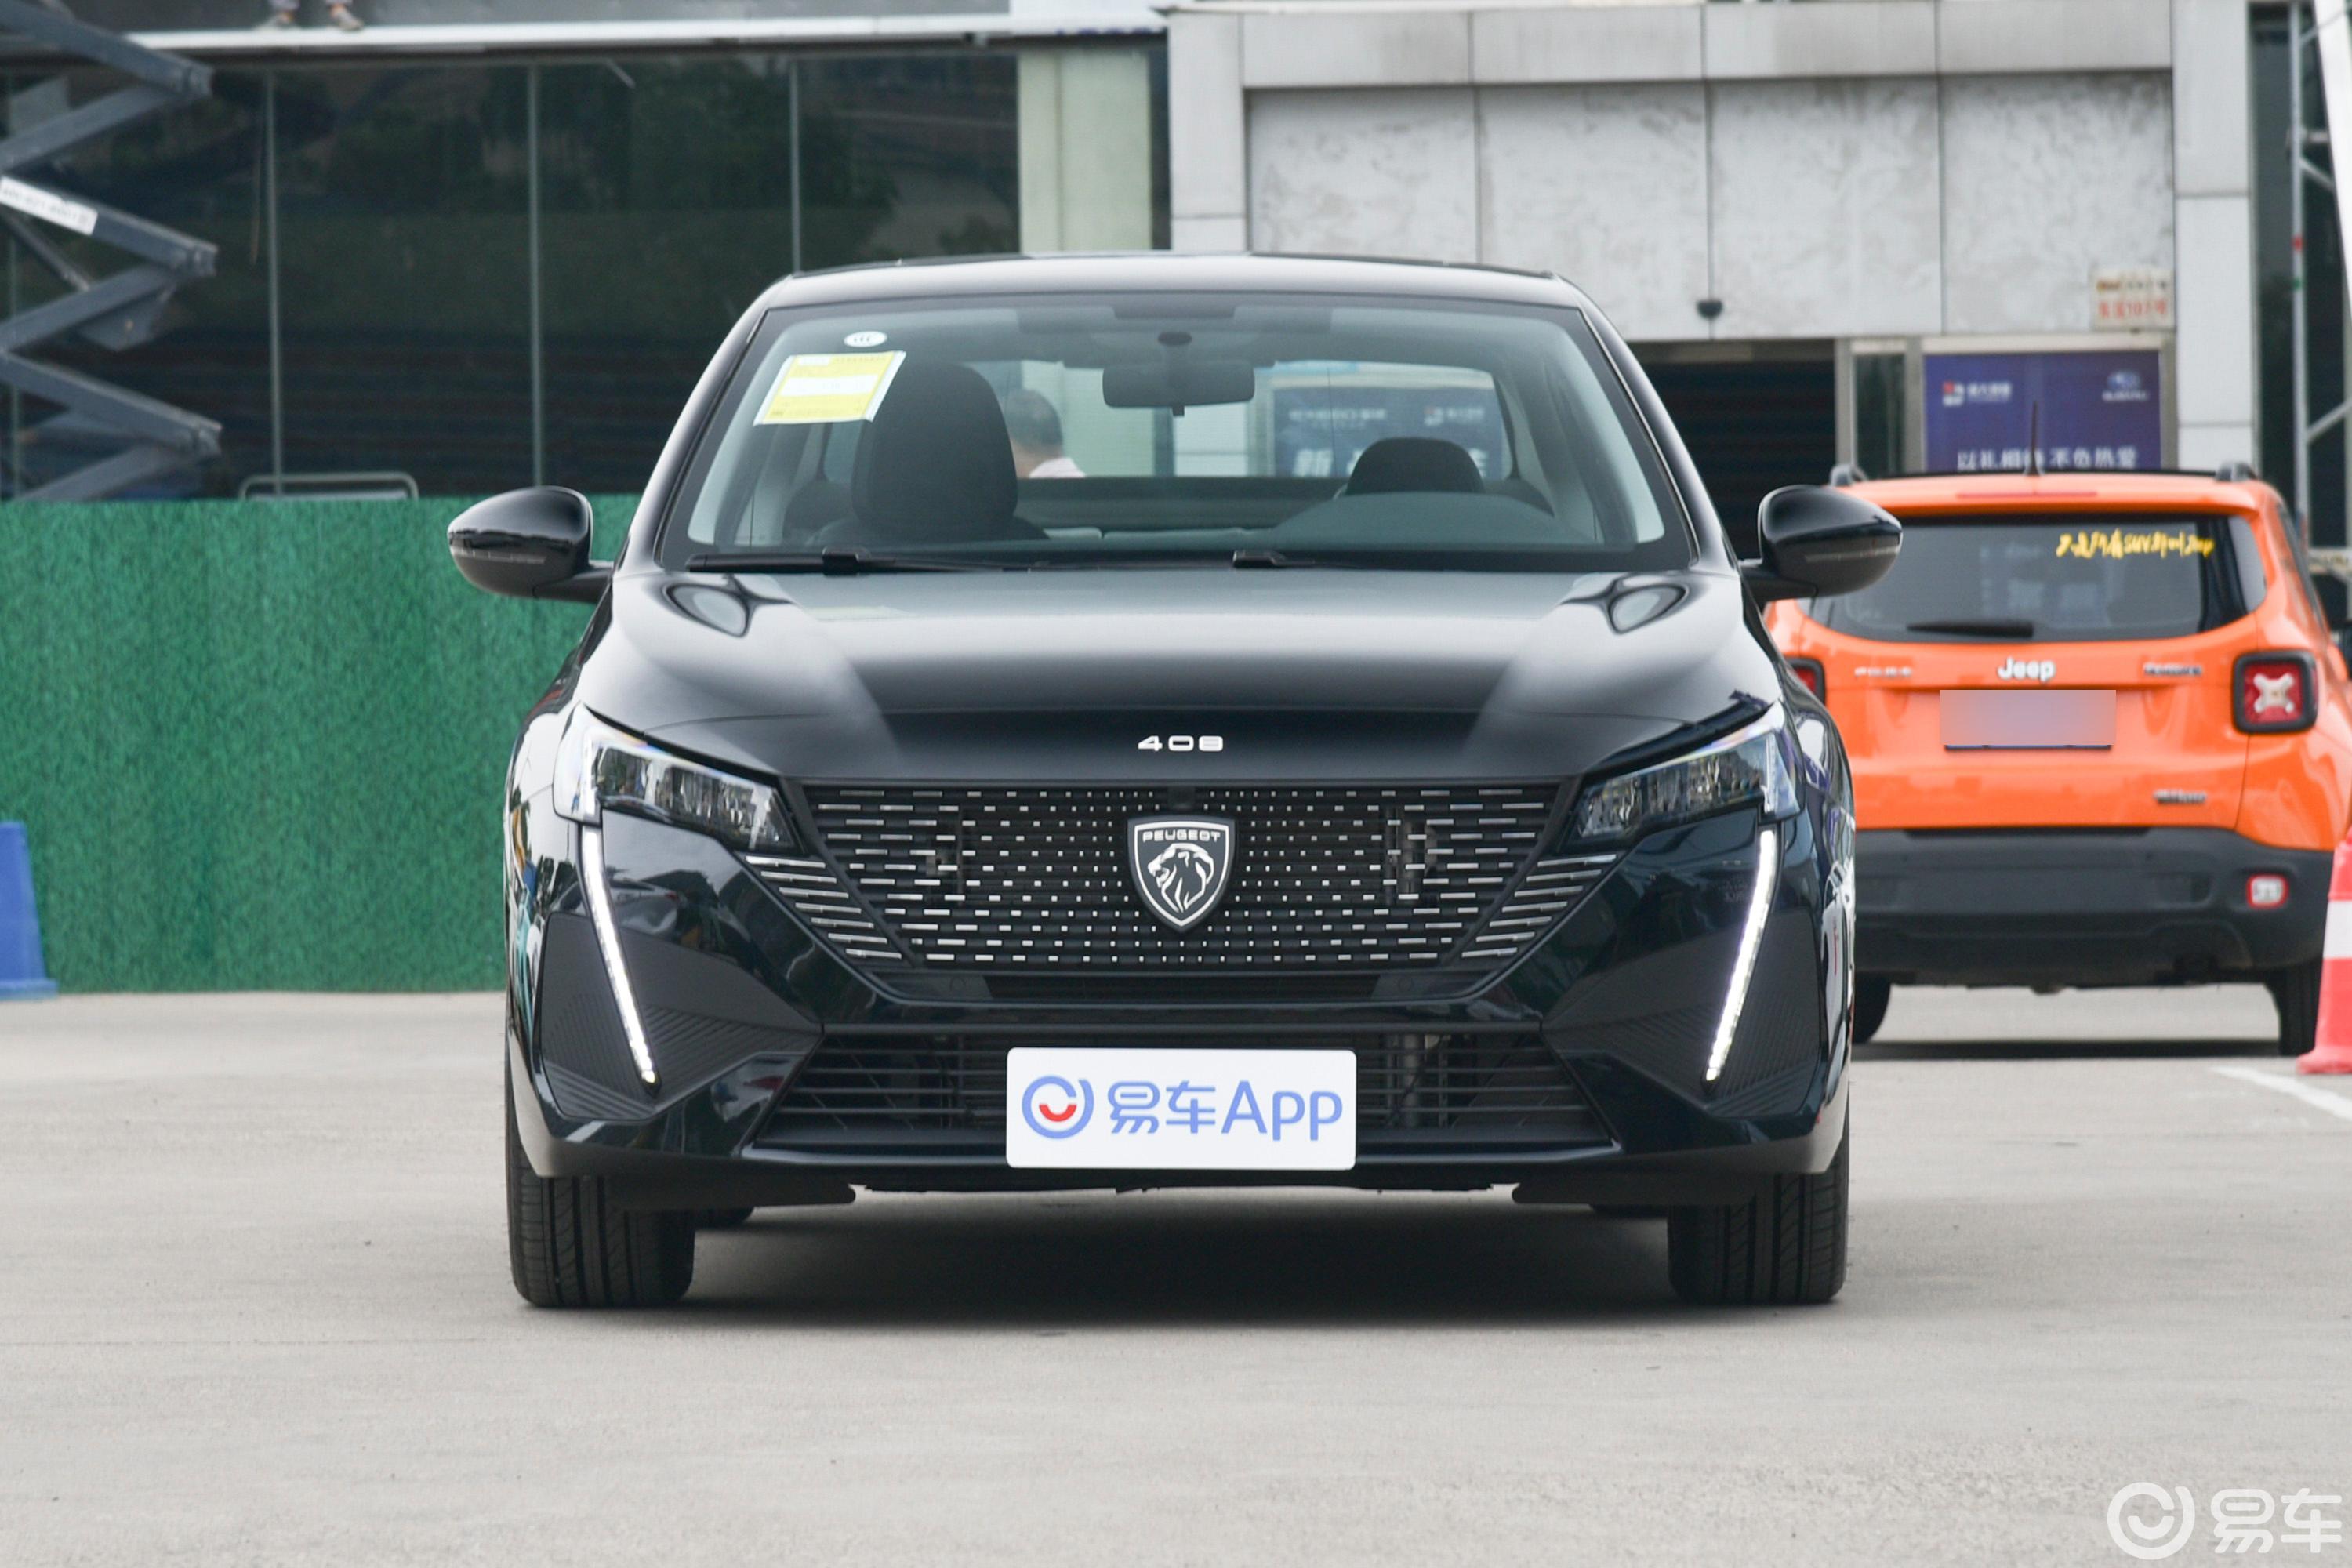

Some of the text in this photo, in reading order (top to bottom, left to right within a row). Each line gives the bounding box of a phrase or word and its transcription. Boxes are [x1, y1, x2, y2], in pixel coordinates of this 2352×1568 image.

[1997, 656, 2056, 683] Jeep
[1138, 735, 1224, 752] 408
[1142, 829, 1221, 843] PEUGEOT
